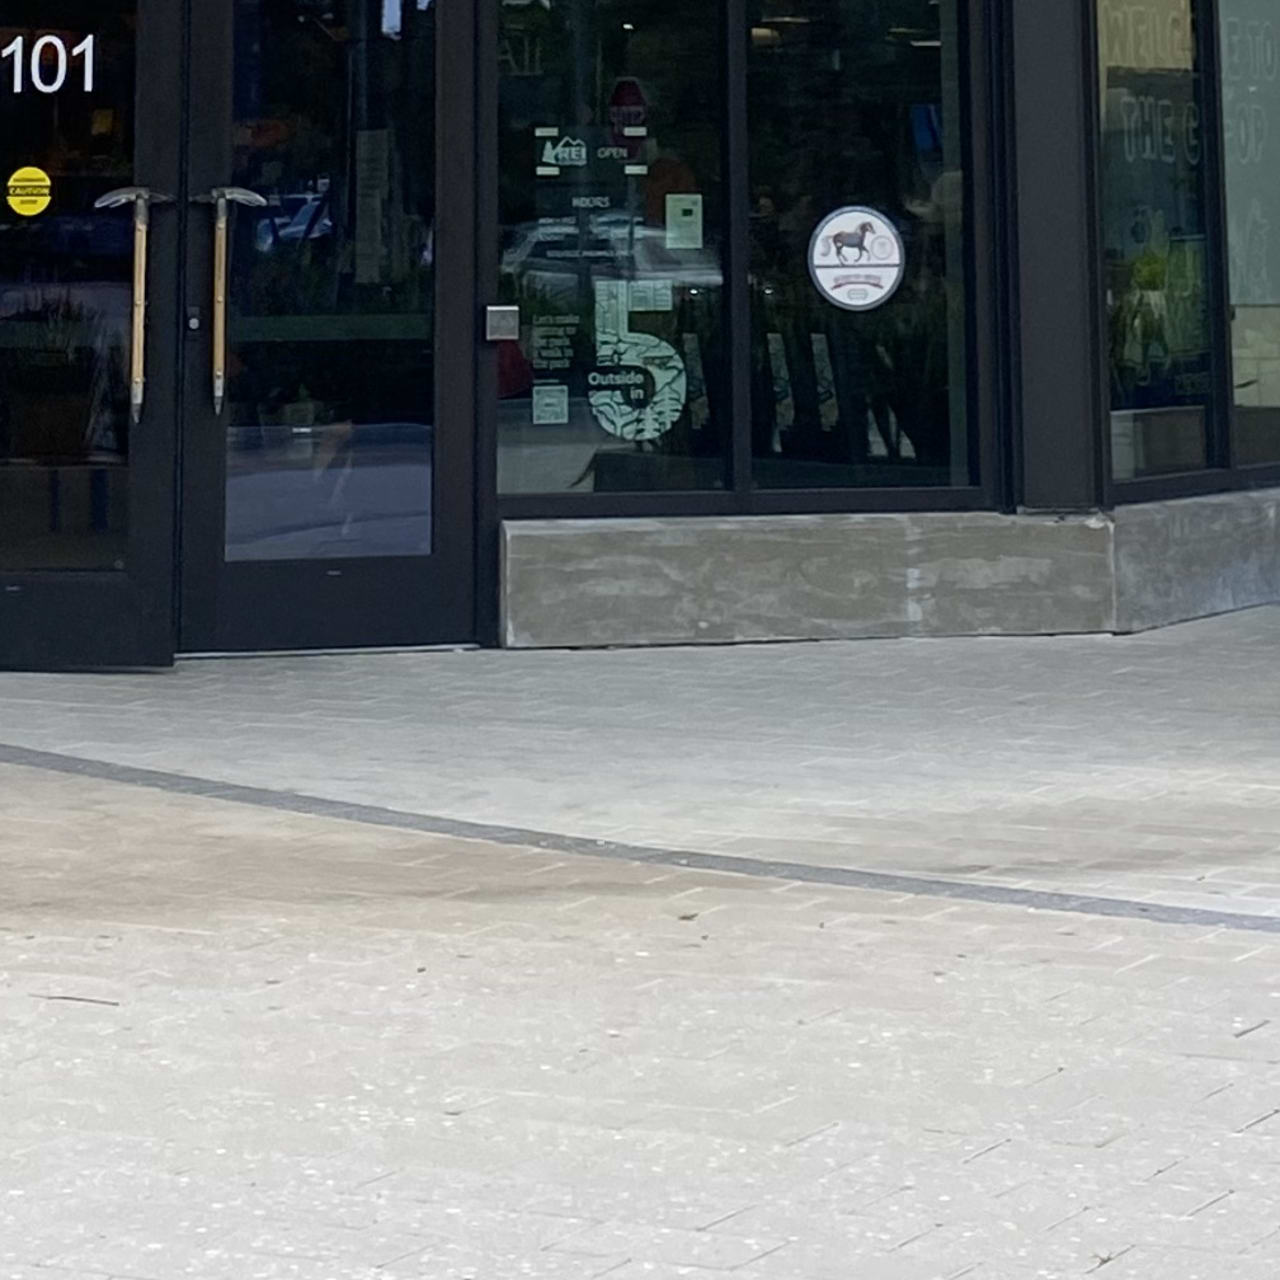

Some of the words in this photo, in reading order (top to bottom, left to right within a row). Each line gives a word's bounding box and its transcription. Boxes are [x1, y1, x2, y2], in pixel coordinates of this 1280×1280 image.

[1120, 95, 1177, 164] THE
[597, 146, 628, 159] OPEN
[572, 196, 610, 208] HOURS
[588, 371, 645, 386] Outside
[630, 387, 644, 400] in
